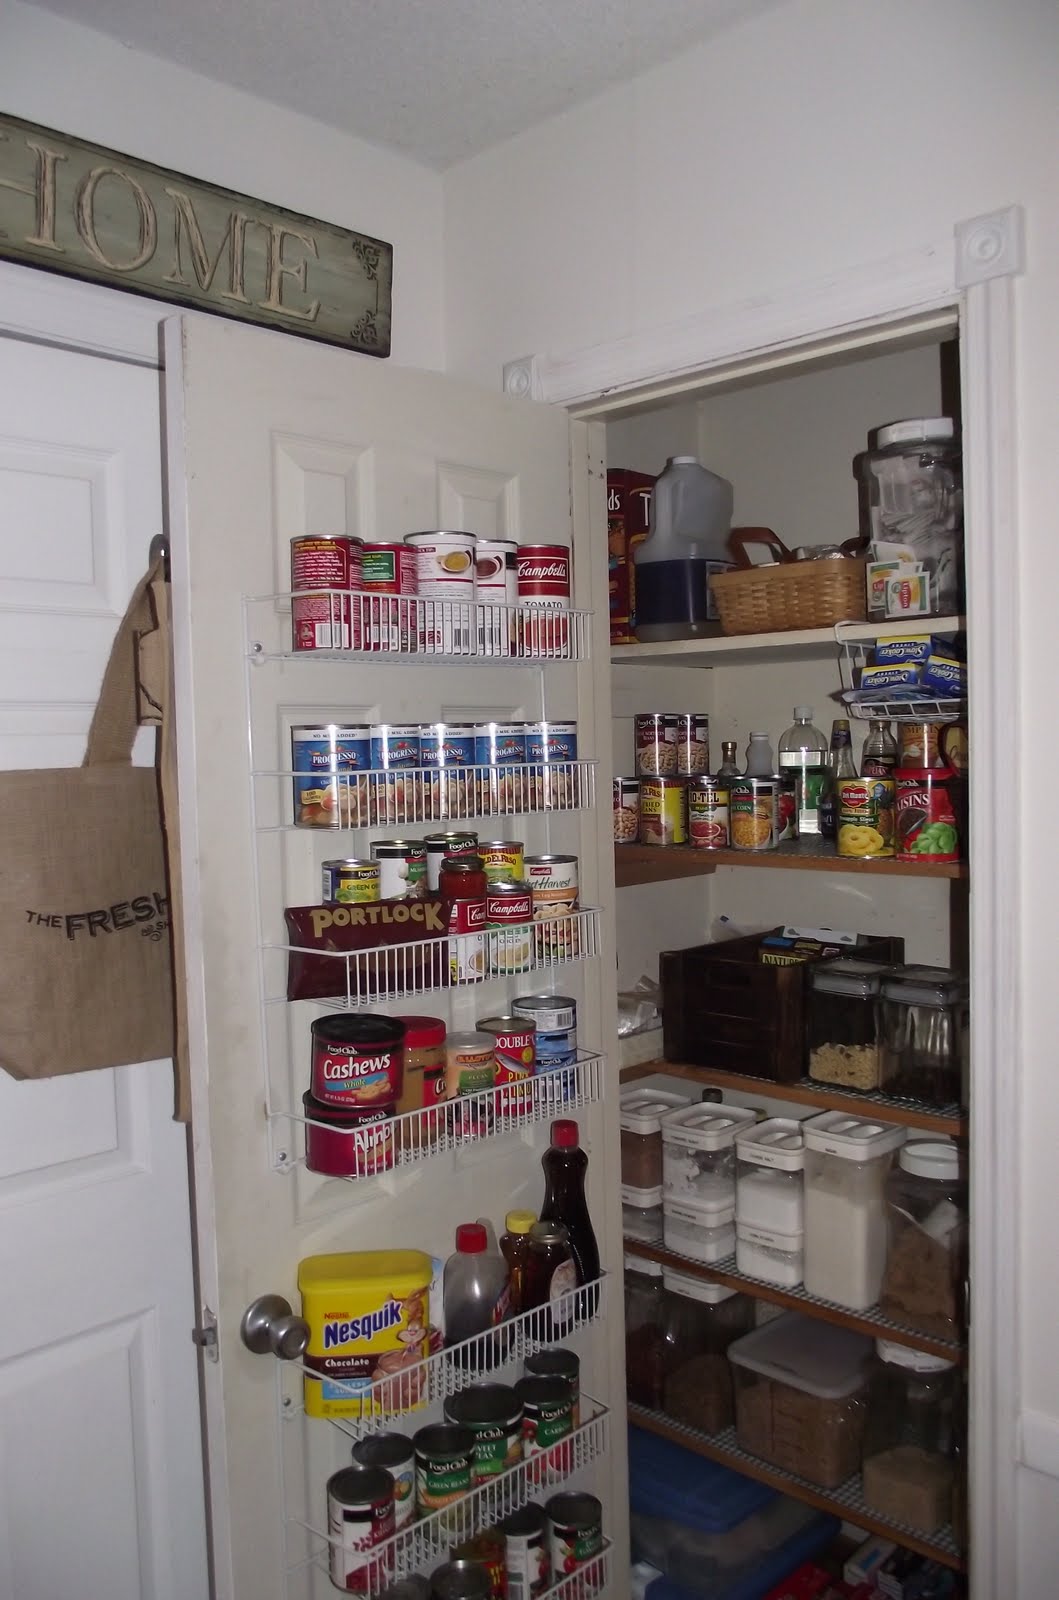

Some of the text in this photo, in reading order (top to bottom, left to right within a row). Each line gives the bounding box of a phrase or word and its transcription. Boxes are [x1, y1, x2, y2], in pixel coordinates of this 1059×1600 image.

[0, 140, 320, 322] HOME
[608, 489, 621, 511] ds
[518, 561, 566, 579] Campbell's
[879, 644, 925, 657] Slow Cooker
[495, 745, 524, 757] ROGRESSO
[897, 793, 930, 811] ISINS
[449, 843, 465, 852] Food
[358, 870, 371, 880] Food
[490, 901, 529, 915] Campbell's
[25, 909, 63, 928] THE
[309, 900, 446, 939] PORTLOCK
[495, 1035, 530, 1049] DOUBLE
[327, 1044, 358, 1055] Food Club
[323, 1053, 391, 1080] Cashews
[343, 1079, 366, 1089] Whole
[353, 1123, 393, 1153] Almo
[324, 1301, 403, 1349] Nesquik
[325, 1358, 370, 1367] Chocolate
[429, 1461, 450, 1475] Food
